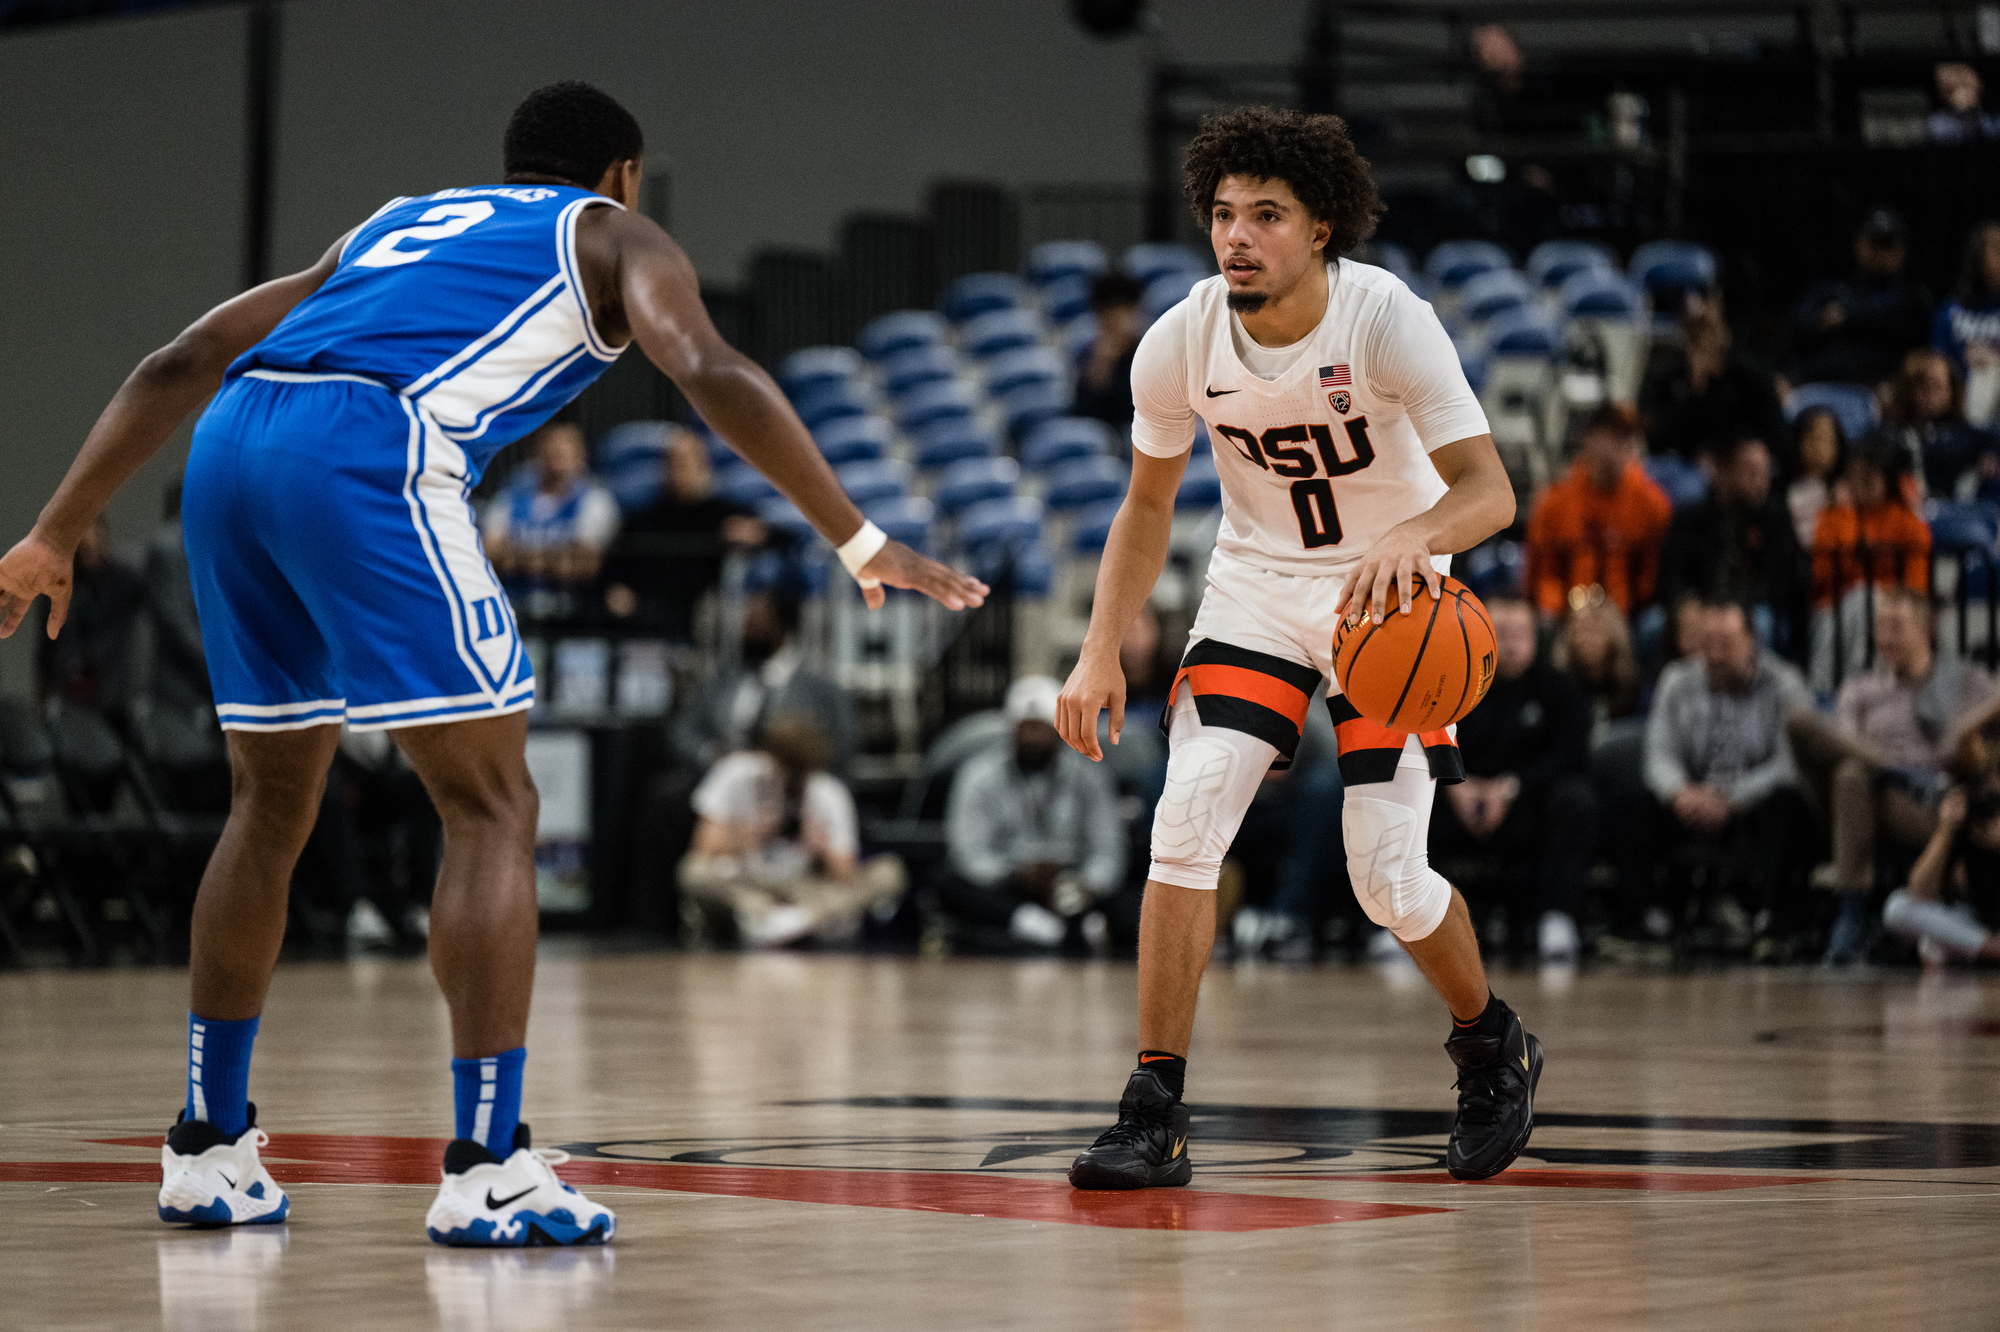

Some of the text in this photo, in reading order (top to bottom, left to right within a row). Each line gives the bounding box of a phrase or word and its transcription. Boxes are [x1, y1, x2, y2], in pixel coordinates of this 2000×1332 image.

[353, 200, 496, 268] 2
[1330, 392, 1350, 408] PAC
[1336, 401, 1348, 411] 12
[1215, 415, 1376, 478] OSU
[1289, 478, 1344, 549] 0
[470, 596, 505, 642] D
